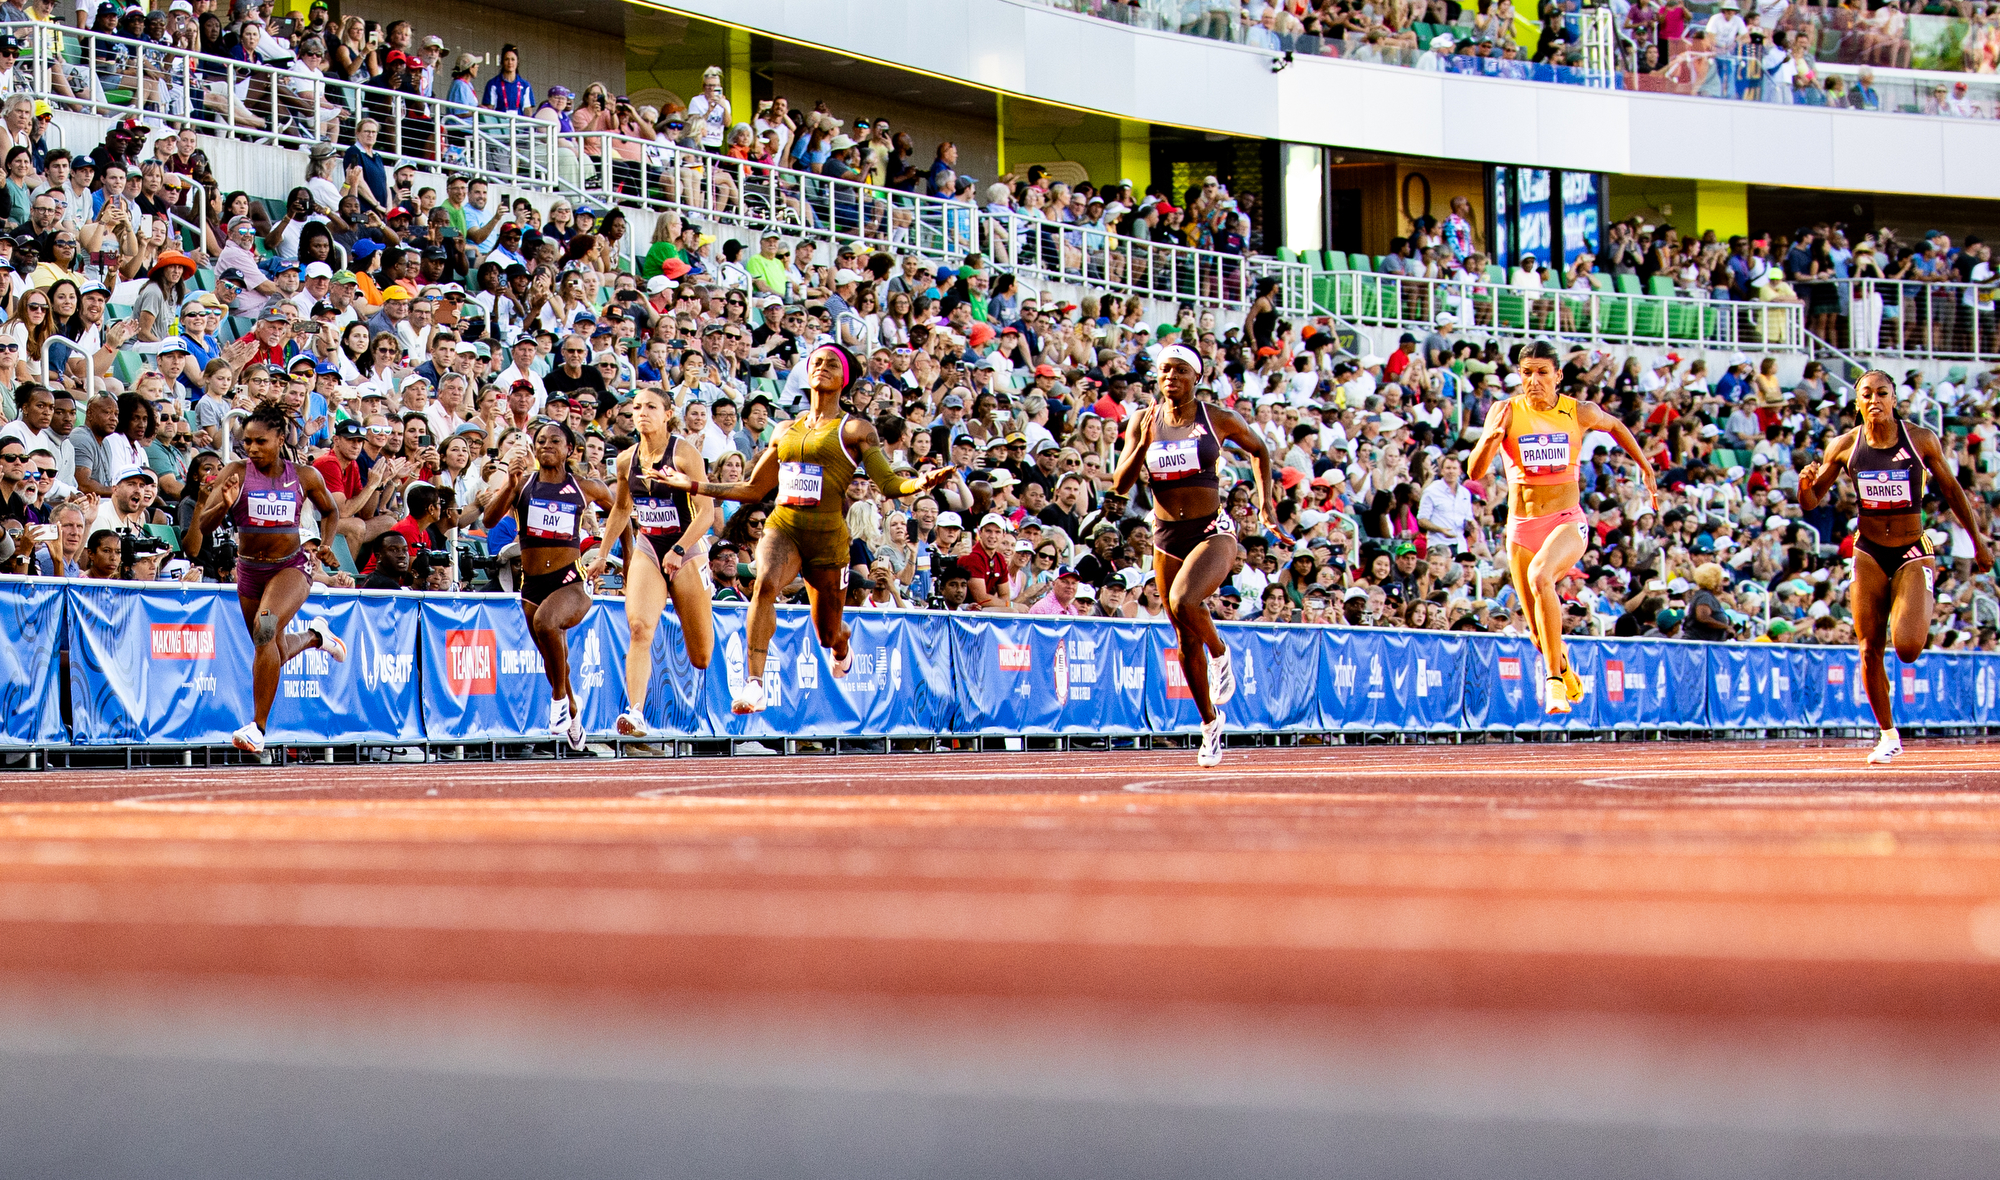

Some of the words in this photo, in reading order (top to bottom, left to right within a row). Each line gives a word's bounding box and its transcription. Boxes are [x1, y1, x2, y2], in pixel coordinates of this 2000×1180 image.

[1159, 454, 1186, 468] DAVIS
[1523, 448, 1566, 462] PRANDINI
[1866, 485, 1903, 497] BARNES
[257, 504, 287, 516] OLIVER
[640, 510, 676, 523] BLACKMON
[542, 514, 561, 527] RAY
[152, 630, 182, 653] MAKING
[182, 630, 198, 653] TEAM
[198, 630, 214, 653] USA
[304, 650, 329, 675] TRIALS
[380, 653, 413, 683] USATF
[451, 645, 474, 680] TEAM
[474, 645, 491, 679] USA
[501, 650, 519, 674] ONE
[520, 650, 536, 674] FOR
[194, 671, 217, 697] xfinity
[1123, 666, 1146, 690] USATF
[284, 680, 300, 698] TRACK
[300, 680, 306, 697] &
[305, 680, 320, 698] FIELD
